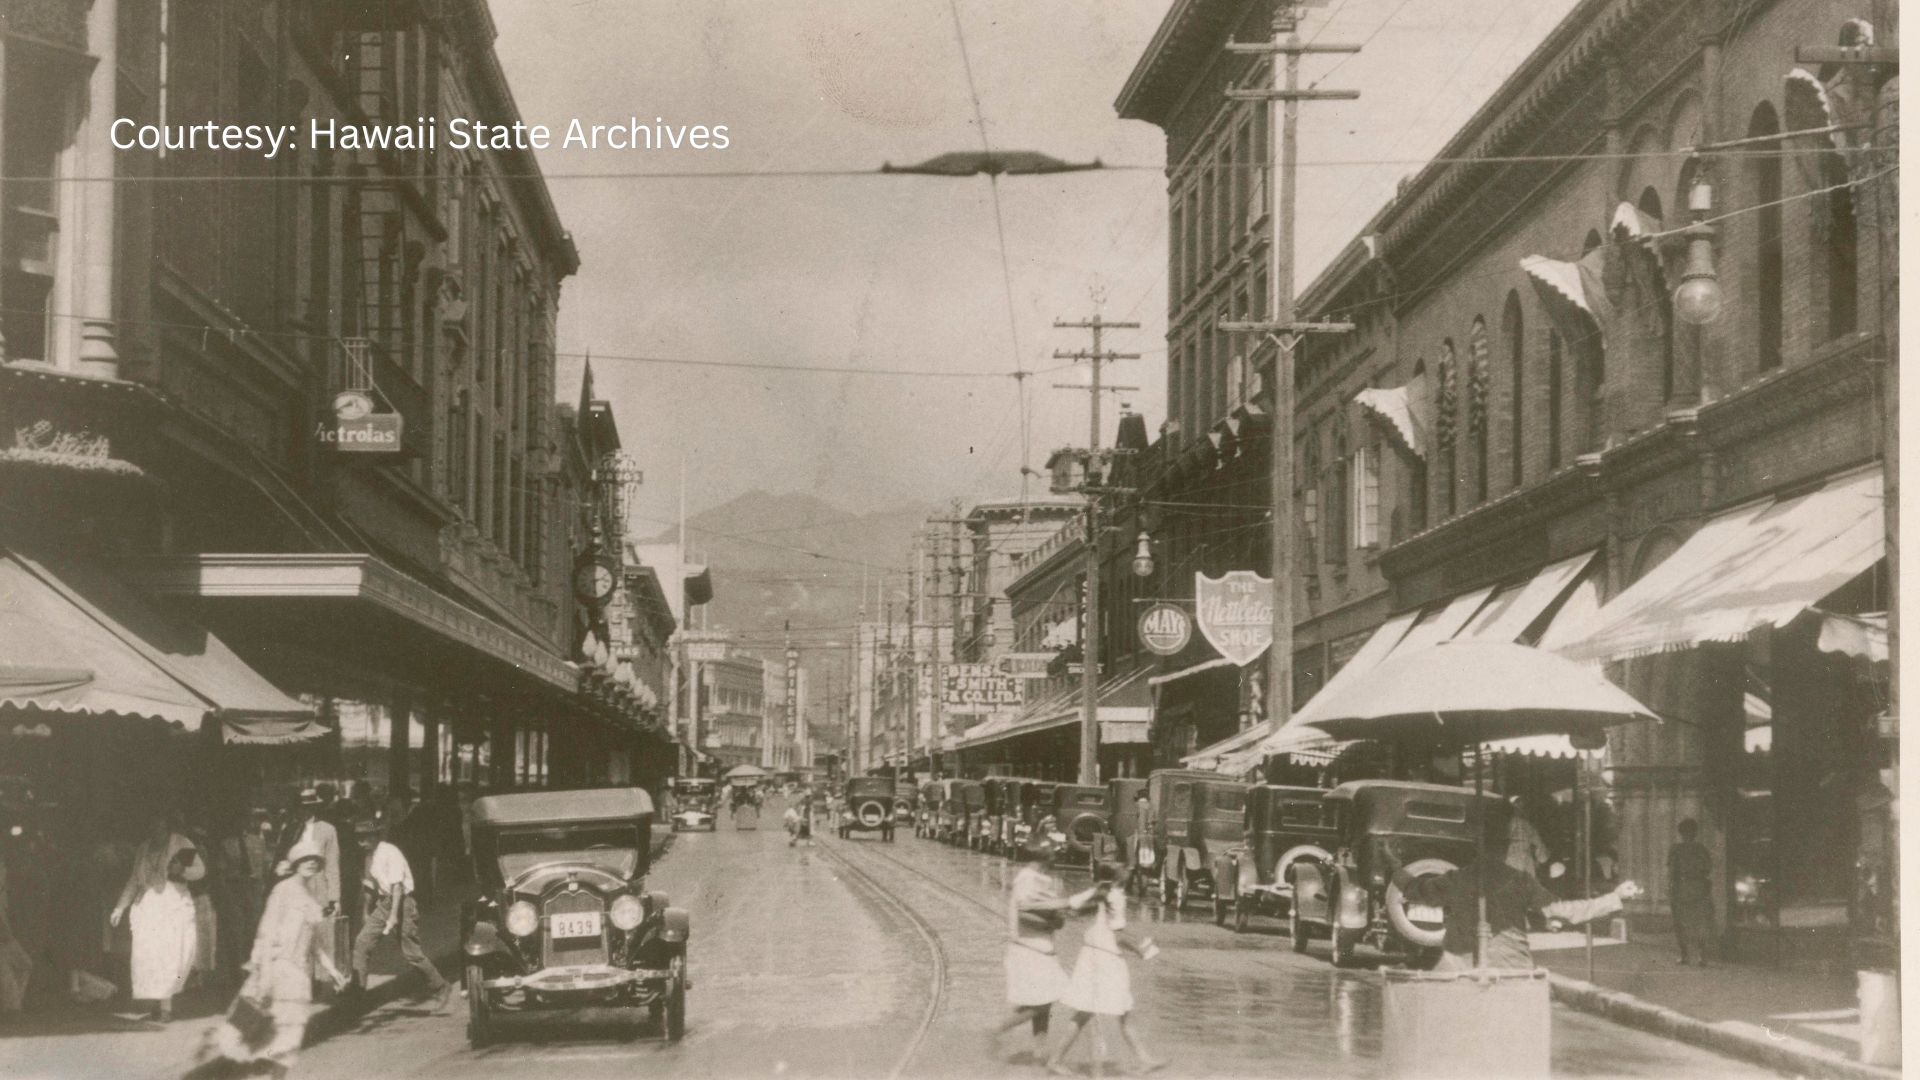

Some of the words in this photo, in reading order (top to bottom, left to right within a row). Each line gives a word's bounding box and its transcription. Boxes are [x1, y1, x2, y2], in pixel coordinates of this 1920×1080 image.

[1227, 581, 1256, 593] THE
[1202, 594, 1273, 625] Nettleto
[1220, 629, 1263, 646] SHOE
[956, 678, 1007, 690] SMITH
[559, 920, 593, 936] 8439
